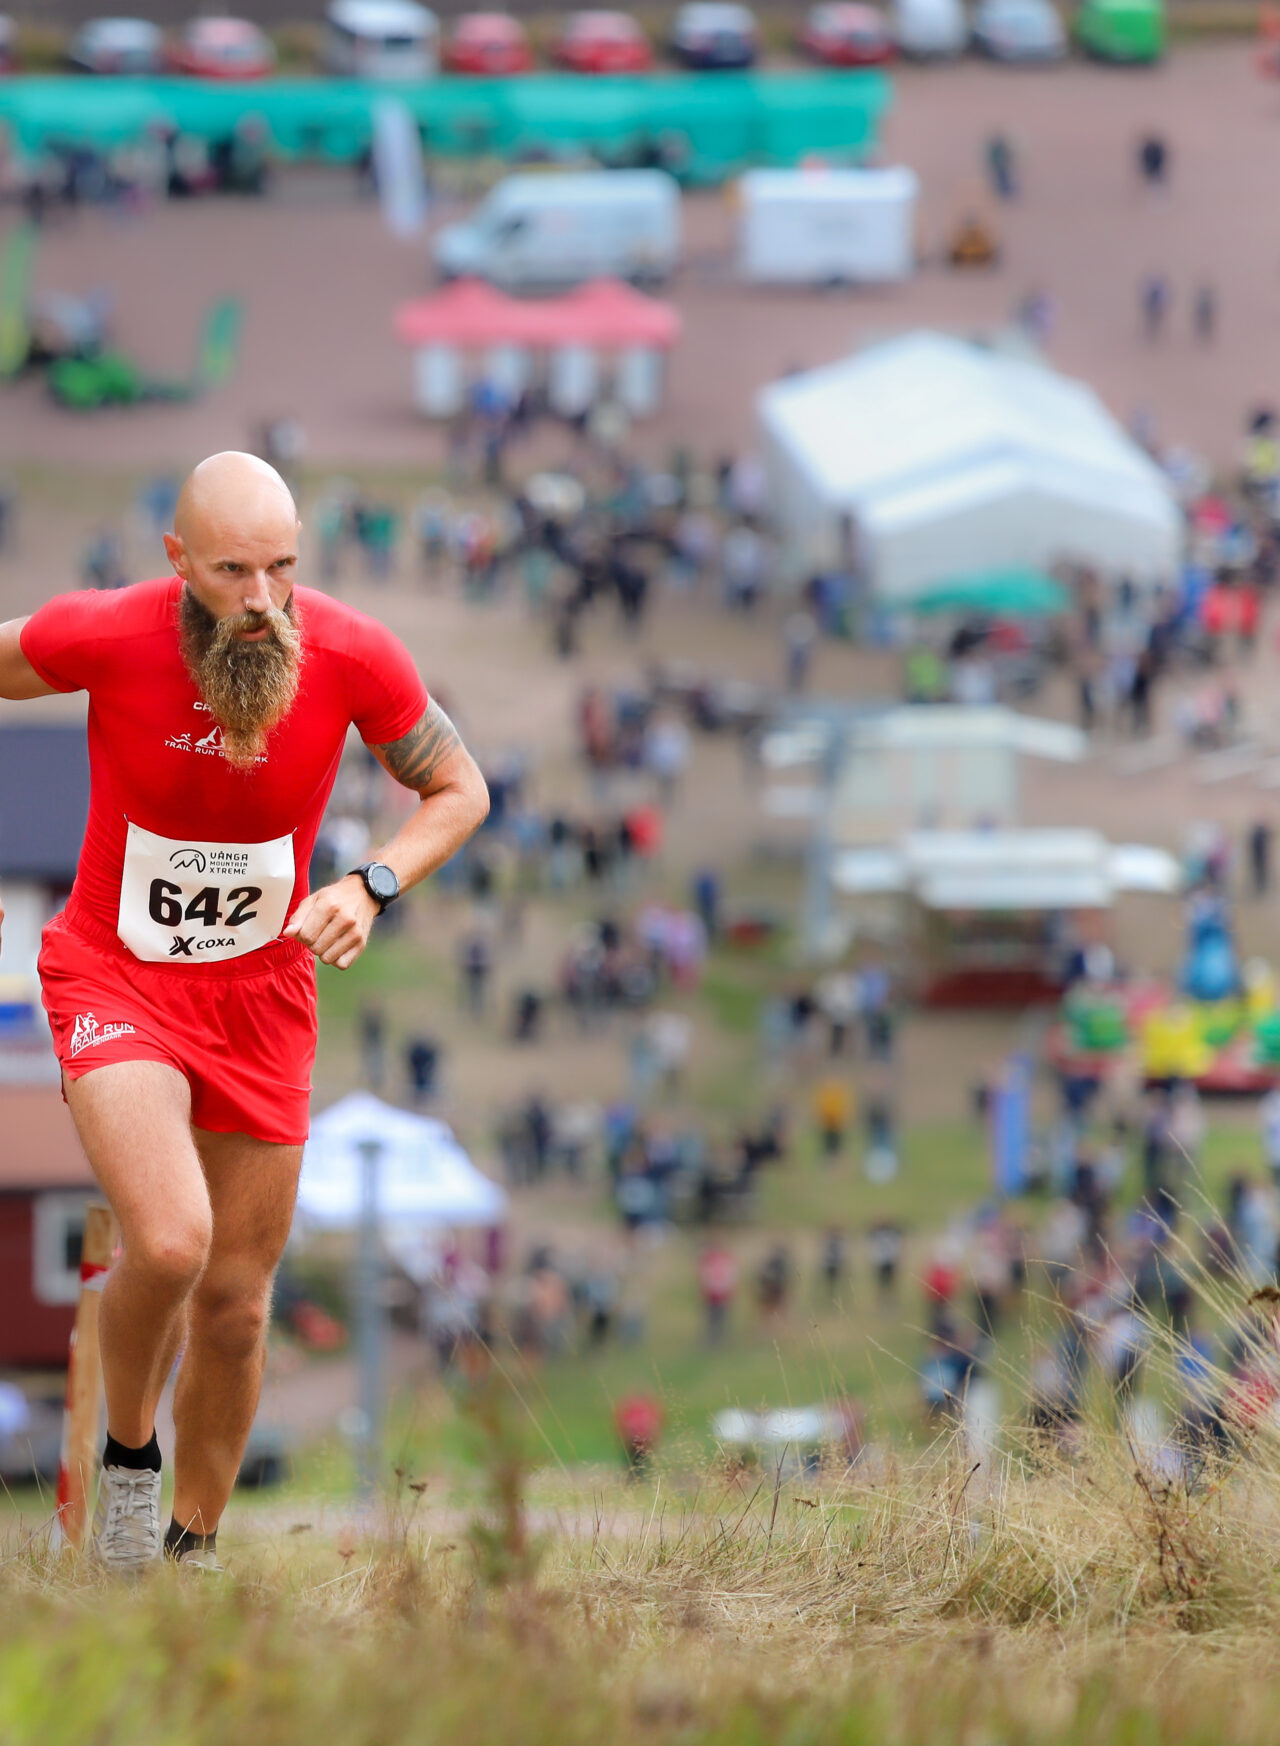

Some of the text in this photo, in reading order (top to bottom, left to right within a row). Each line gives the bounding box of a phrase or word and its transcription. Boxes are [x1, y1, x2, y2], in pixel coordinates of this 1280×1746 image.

[164, 739, 192, 752] TRAIL
[194, 747, 215, 756] RUN
[210, 851, 248, 861] VÅNGA
[209, 867, 247, 875] XTREME
[148, 878, 262, 927] 642
[196, 937, 236, 950] COXA
[70, 1022, 134, 1055] TRAIL RUN
[92, 1034, 122, 1047] DENMARK
